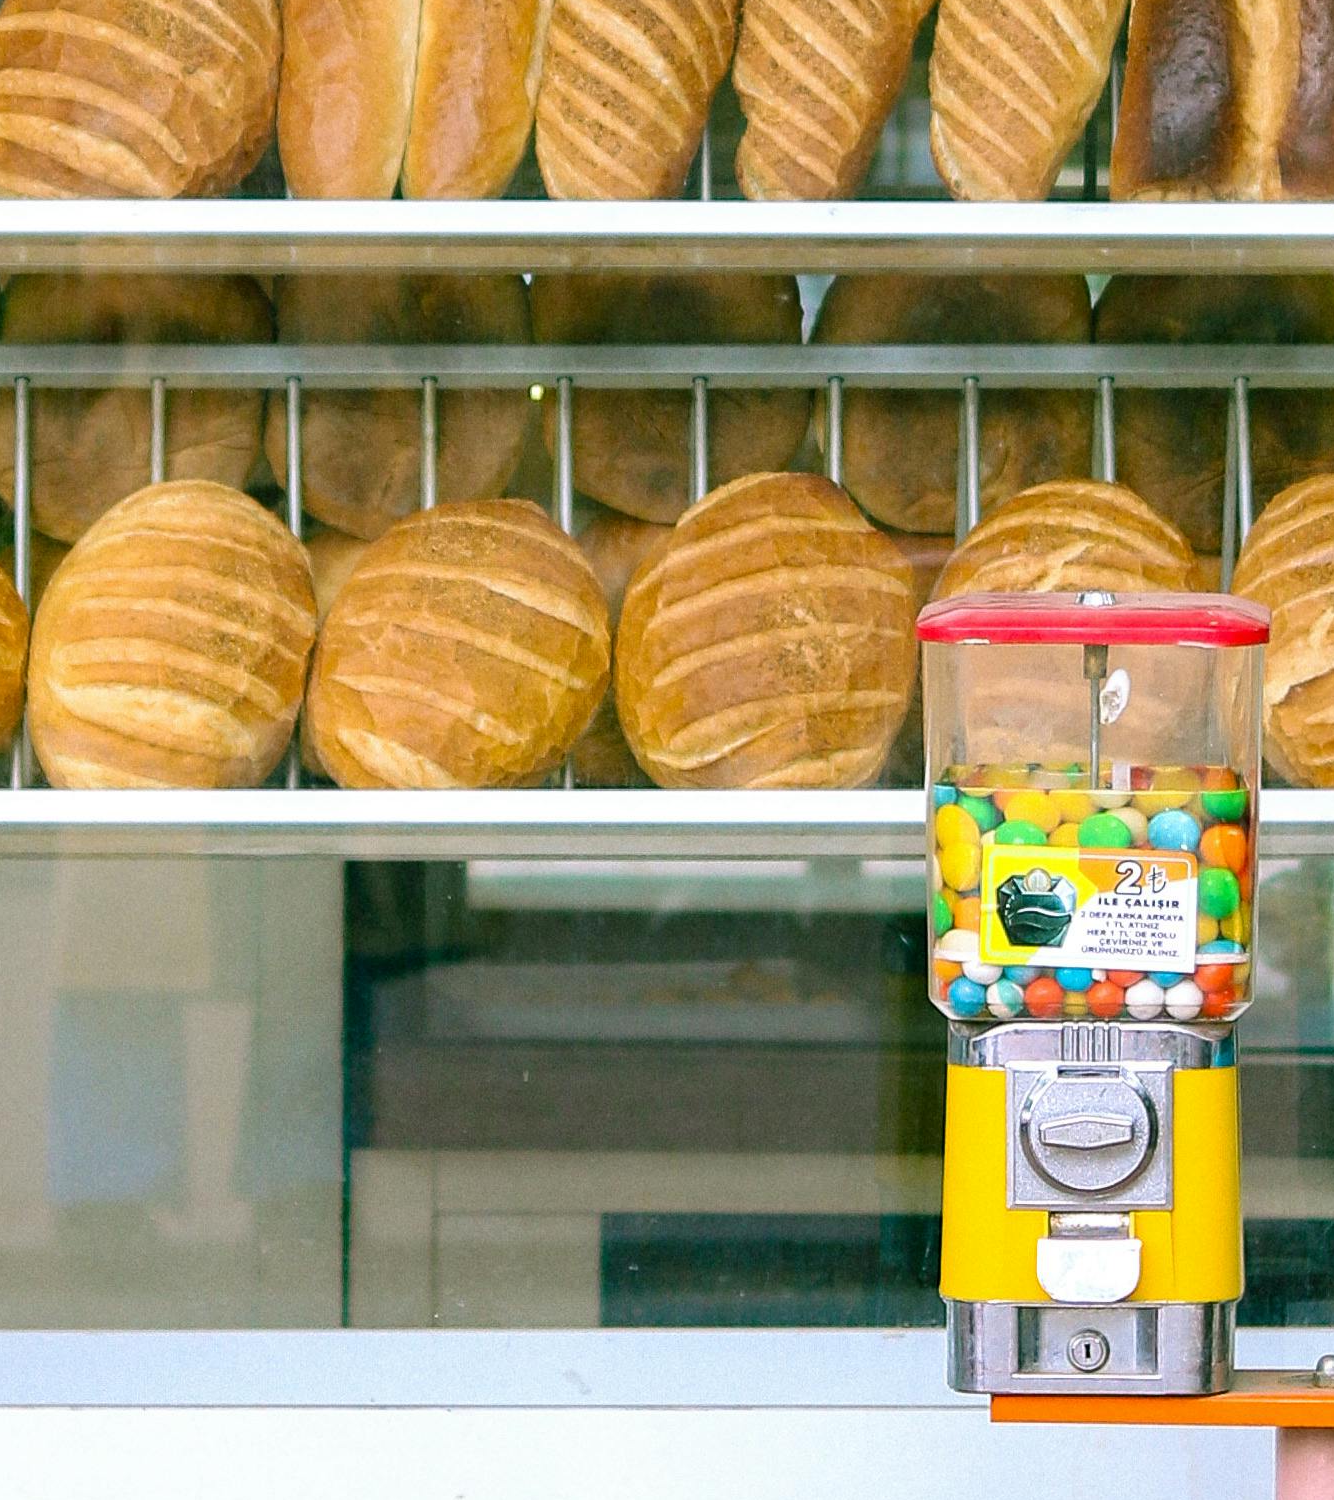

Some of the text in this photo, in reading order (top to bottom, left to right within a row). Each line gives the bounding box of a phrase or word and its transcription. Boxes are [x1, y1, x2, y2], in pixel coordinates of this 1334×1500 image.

[1125, 898, 1180, 910] ÇALIŞIR
[1089, 911, 1113, 919] DEFA
[1147, 914, 1184, 922] ARKAYA
[1128, 922, 1160, 930] ATINIZ
